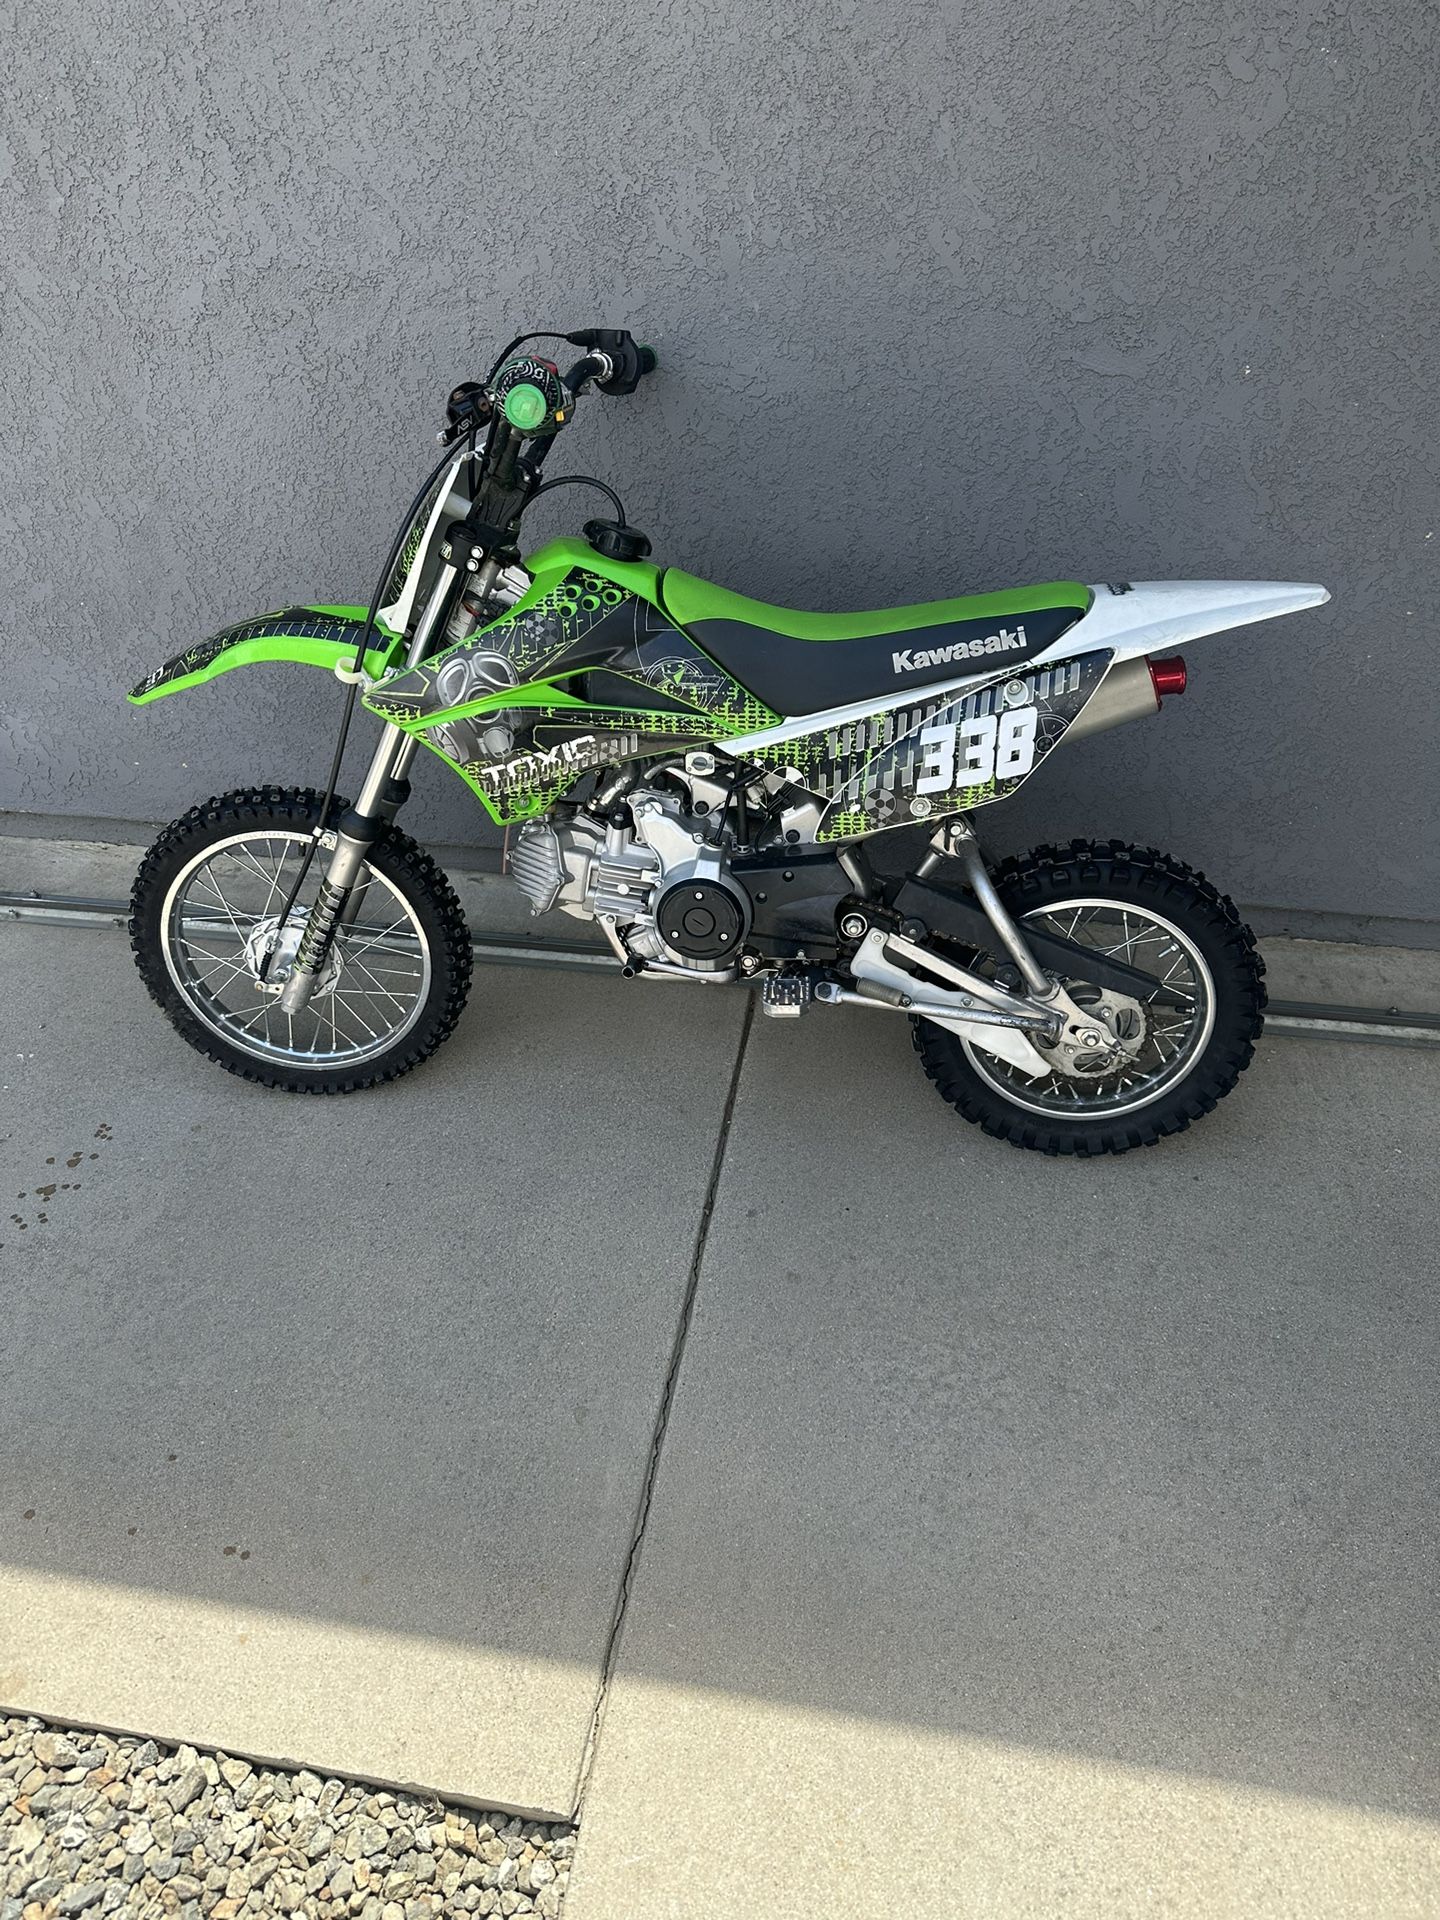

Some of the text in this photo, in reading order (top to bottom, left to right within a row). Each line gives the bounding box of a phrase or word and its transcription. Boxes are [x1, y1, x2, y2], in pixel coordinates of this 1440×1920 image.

[892, 626, 1027, 673] Kawasaki
[480, 735, 597, 790] TOXIC
[916, 706, 1038, 794] 338
